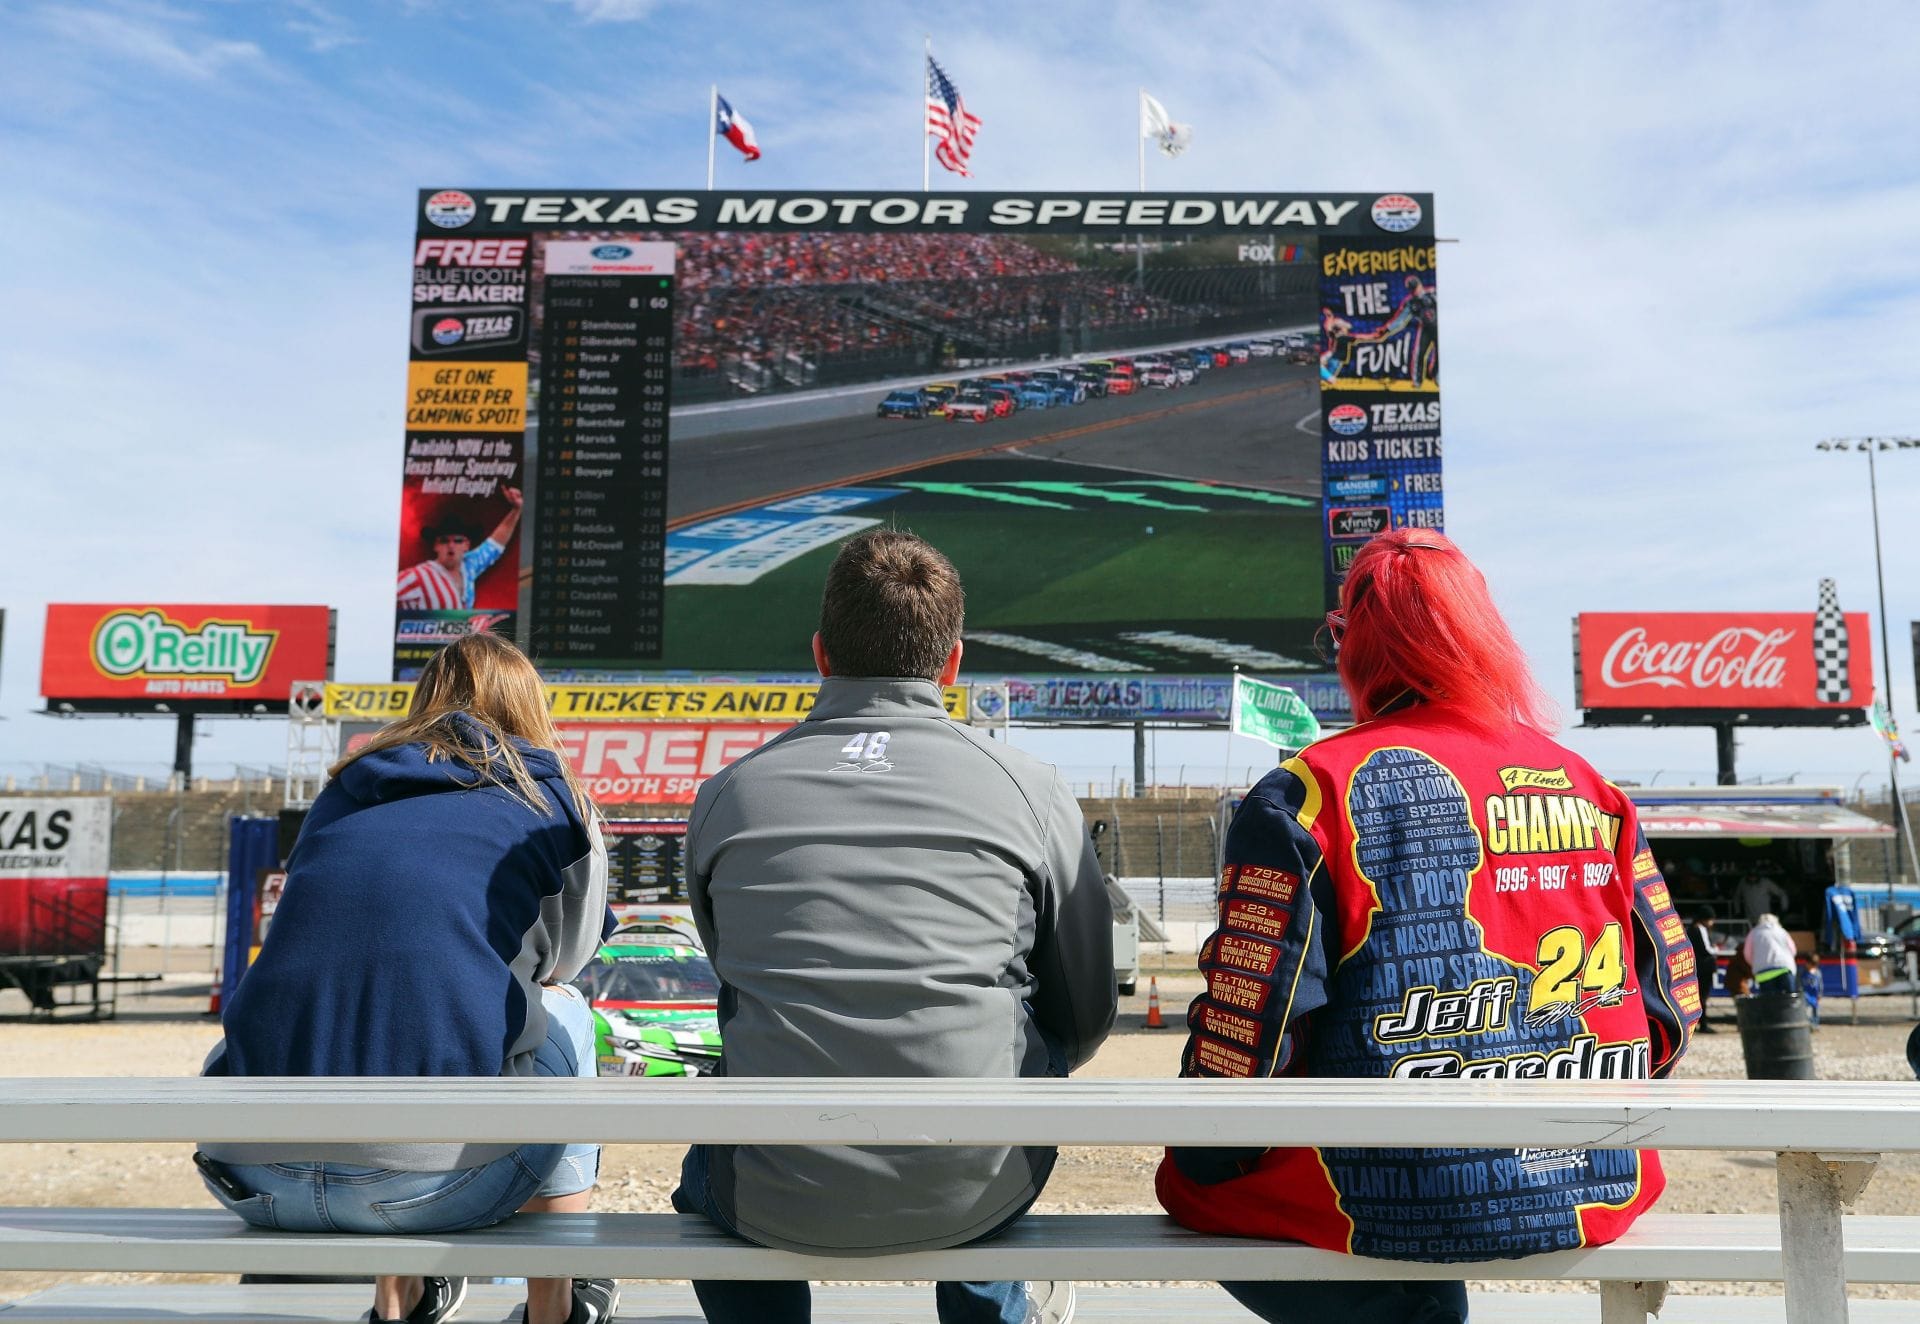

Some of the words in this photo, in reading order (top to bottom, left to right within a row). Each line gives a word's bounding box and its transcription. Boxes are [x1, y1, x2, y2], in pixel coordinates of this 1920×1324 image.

[485, 198, 699, 223] TEXAS
[717, 198, 968, 224] MOTOR
[989, 199, 1358, 225] SPEEDWAY
[415, 239, 528, 267] FREE
[1238, 245, 1275, 261] FOX
[1324, 247, 1435, 276] EXPERIENCE
[414, 268, 526, 283] BLUETOOTH
[413, 285, 525, 302] SPEAKER!
[1340, 283, 1390, 316] THE
[629, 297, 639, 309] 8
[650, 297, 668, 309] 60
[466, 316, 513, 334] TEXAS
[1356, 332, 1411, 375] FUN!
[434, 369, 462, 385] GET
[464, 369, 496, 385] ONE
[578, 369, 610, 381] Byron
[415, 388, 481, 404] SPEAKER
[484, 388, 513, 404] PER
[577, 385, 619, 396] Wallace
[576, 401, 616, 413] Logano
[1370, 402, 1440, 424] TEXAS
[406, 408, 474, 424] CAMPING
[476, 408, 520, 424] SPOT!
[576, 417, 625, 428] Buescher
[409, 438, 456, 456] Available
[455, 438, 484, 456] NOW
[482, 441, 495, 456] at
[494, 439, 513, 456] the
[576, 433, 616, 444] Harvick
[575, 449, 622, 460] Bowman
[1328, 440, 1369, 462] KIDS
[1373, 436, 1443, 460] TICKETS
[404, 457, 434, 475] Texas
[433, 457, 466, 475] Motor
[465, 458, 518, 479] Speedway
[574, 466, 614, 479] Bowyer
[421, 476, 457, 494] Infield
[455, 476, 498, 498] Display!
[1336, 481, 1379, 491] GANDER
[574, 490, 605, 500] Dillon
[1340, 516, 1380, 532] xfinity
[1407, 508, 1443, 528] FREE
[573, 523, 615, 534] Reddick
[572, 540, 624, 550] McDowell
[571, 557, 607, 567] LaJoie
[570, 573, 619, 585] Gaughan
[570, 590, 618, 600] Chastain
[569, 607, 602, 617] Mears
[569, 624, 611, 634] McLeod
[104, 619, 263, 675] O'Reilly
[568, 640, 596, 651] Ware
[1601, 627, 1797, 688] Coca-Cola
[145, 680, 181, 693] AUTO
[183, 680, 226, 694] PARTS
[1162, 681, 1207, 710] while
[1240, 683, 1256, 705] NO
[334, 691, 408, 710] 2019
[566, 692, 705, 712] TICKETS
[711, 692, 786, 712] AND
[1521, 770, 1567, 786] Time
[1364, 778, 1416, 809] SERIES
[1395, 841, 1424, 855] WINNER
[1429, 839, 1435, 852] 3
[1435, 838, 1455, 851] TIME
[1442, 851, 1480, 867] RACE
[1254, 867, 1283, 881] 797
[1496, 867, 1529, 893] 1995
[1538, 865, 1570, 890] 1997
[1583, 862, 1613, 887] 1998
[1270, 880, 1293, 895] NASCAR
[1381, 874, 1408, 913] AT
[1411, 867, 1469, 908] POCO
[1247, 903, 1267, 916] 23
[1418, 909, 1452, 920] WINNER
[1228, 918, 1249, 929] WITH
[1249, 923, 1256, 931] A
[1257, 924, 1280, 937] POLE
[1224, 937, 1232, 946] 6
[1240, 940, 1273, 955] TIME
[1394, 921, 1462, 956] NASCAR
[1220, 952, 1268, 973] WINNER
[1528, 922, 1627, 1010] 24
[1214, 972, 1223, 982] 5
[1230, 975, 1262, 992] TIME
[1358, 962, 1399, 1001] CAR
[1403, 956, 1445, 989] CUP
[1211, 989, 1257, 1010] WINNER
[1206, 1008, 1215, 1017] 5
[1222, 1013, 1255, 1029] TIME
[1377, 980, 1515, 1040] Jeff
[1206, 1022, 1254, 1046] WINNER
[629, 1062, 648, 1077] 18
[1232, 1060, 1250, 1075] SEASON
[1527, 1149, 1587, 1161] MOTORSPORTS
[1417, 1159, 1489, 1199] MOTOR
[1488, 1188, 1585, 1215] SPEEDWAY
[1412, 1222, 1443, 1238] SEASON
[1452, 1222, 1462, 1235] 13
[1463, 1220, 1483, 1235] WINS
[1483, 1221, 1492, 1233] IN
[1494, 1217, 1512, 1231] 1998
[1519, 1216, 1525, 1230] 5
[1526, 1214, 1544, 1229] TIME
[1371, 1236, 1421, 1253] 1998
[1427, 1231, 1551, 1253] CHARLOTTE
